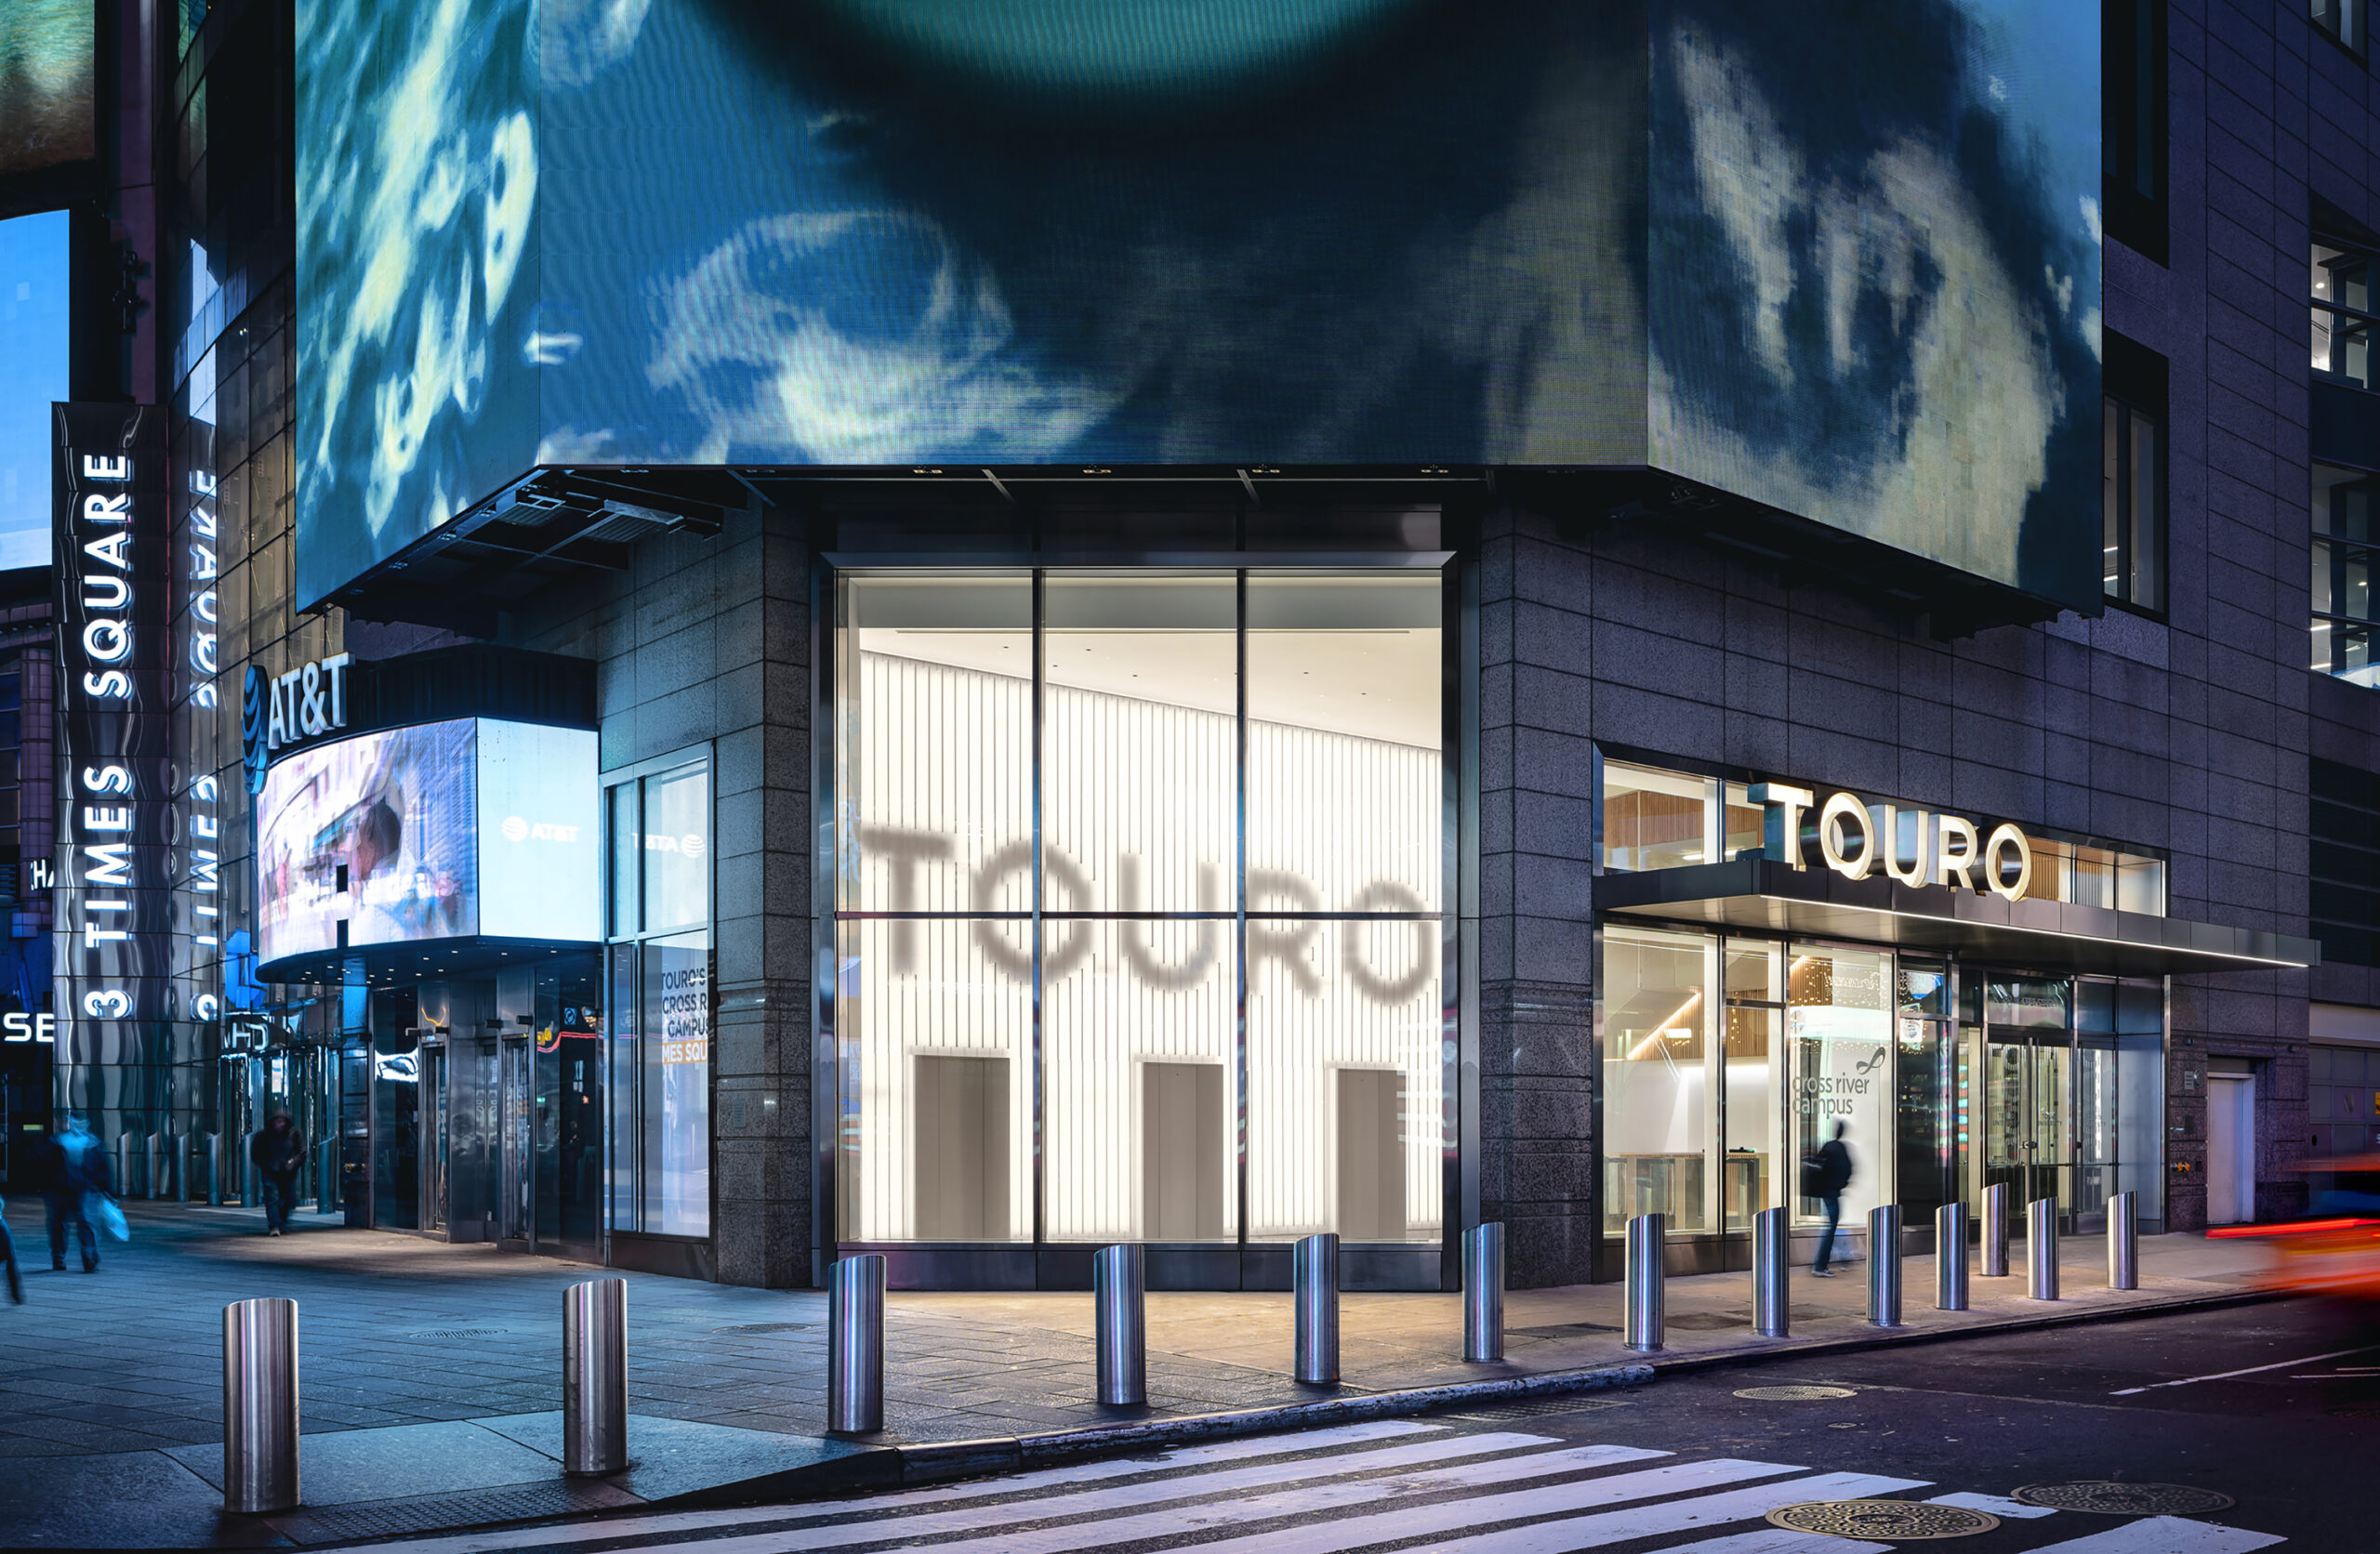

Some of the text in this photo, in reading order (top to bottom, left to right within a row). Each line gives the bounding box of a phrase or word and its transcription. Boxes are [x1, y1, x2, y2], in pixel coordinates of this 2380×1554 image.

[268, 652, 355, 749] AT&T
[84, 454, 130, 1018] 3 TIMES SQUARE
[531, 823, 581, 842] AT&T
[1765, 783, 2031, 902] TOURO
[858, 823, 1435, 1007] TOURO
[662, 993, 696, 1014] CROSS
[1792, 1073, 1870, 1094] cross river
[1792, 1097, 1853, 1119] campus
